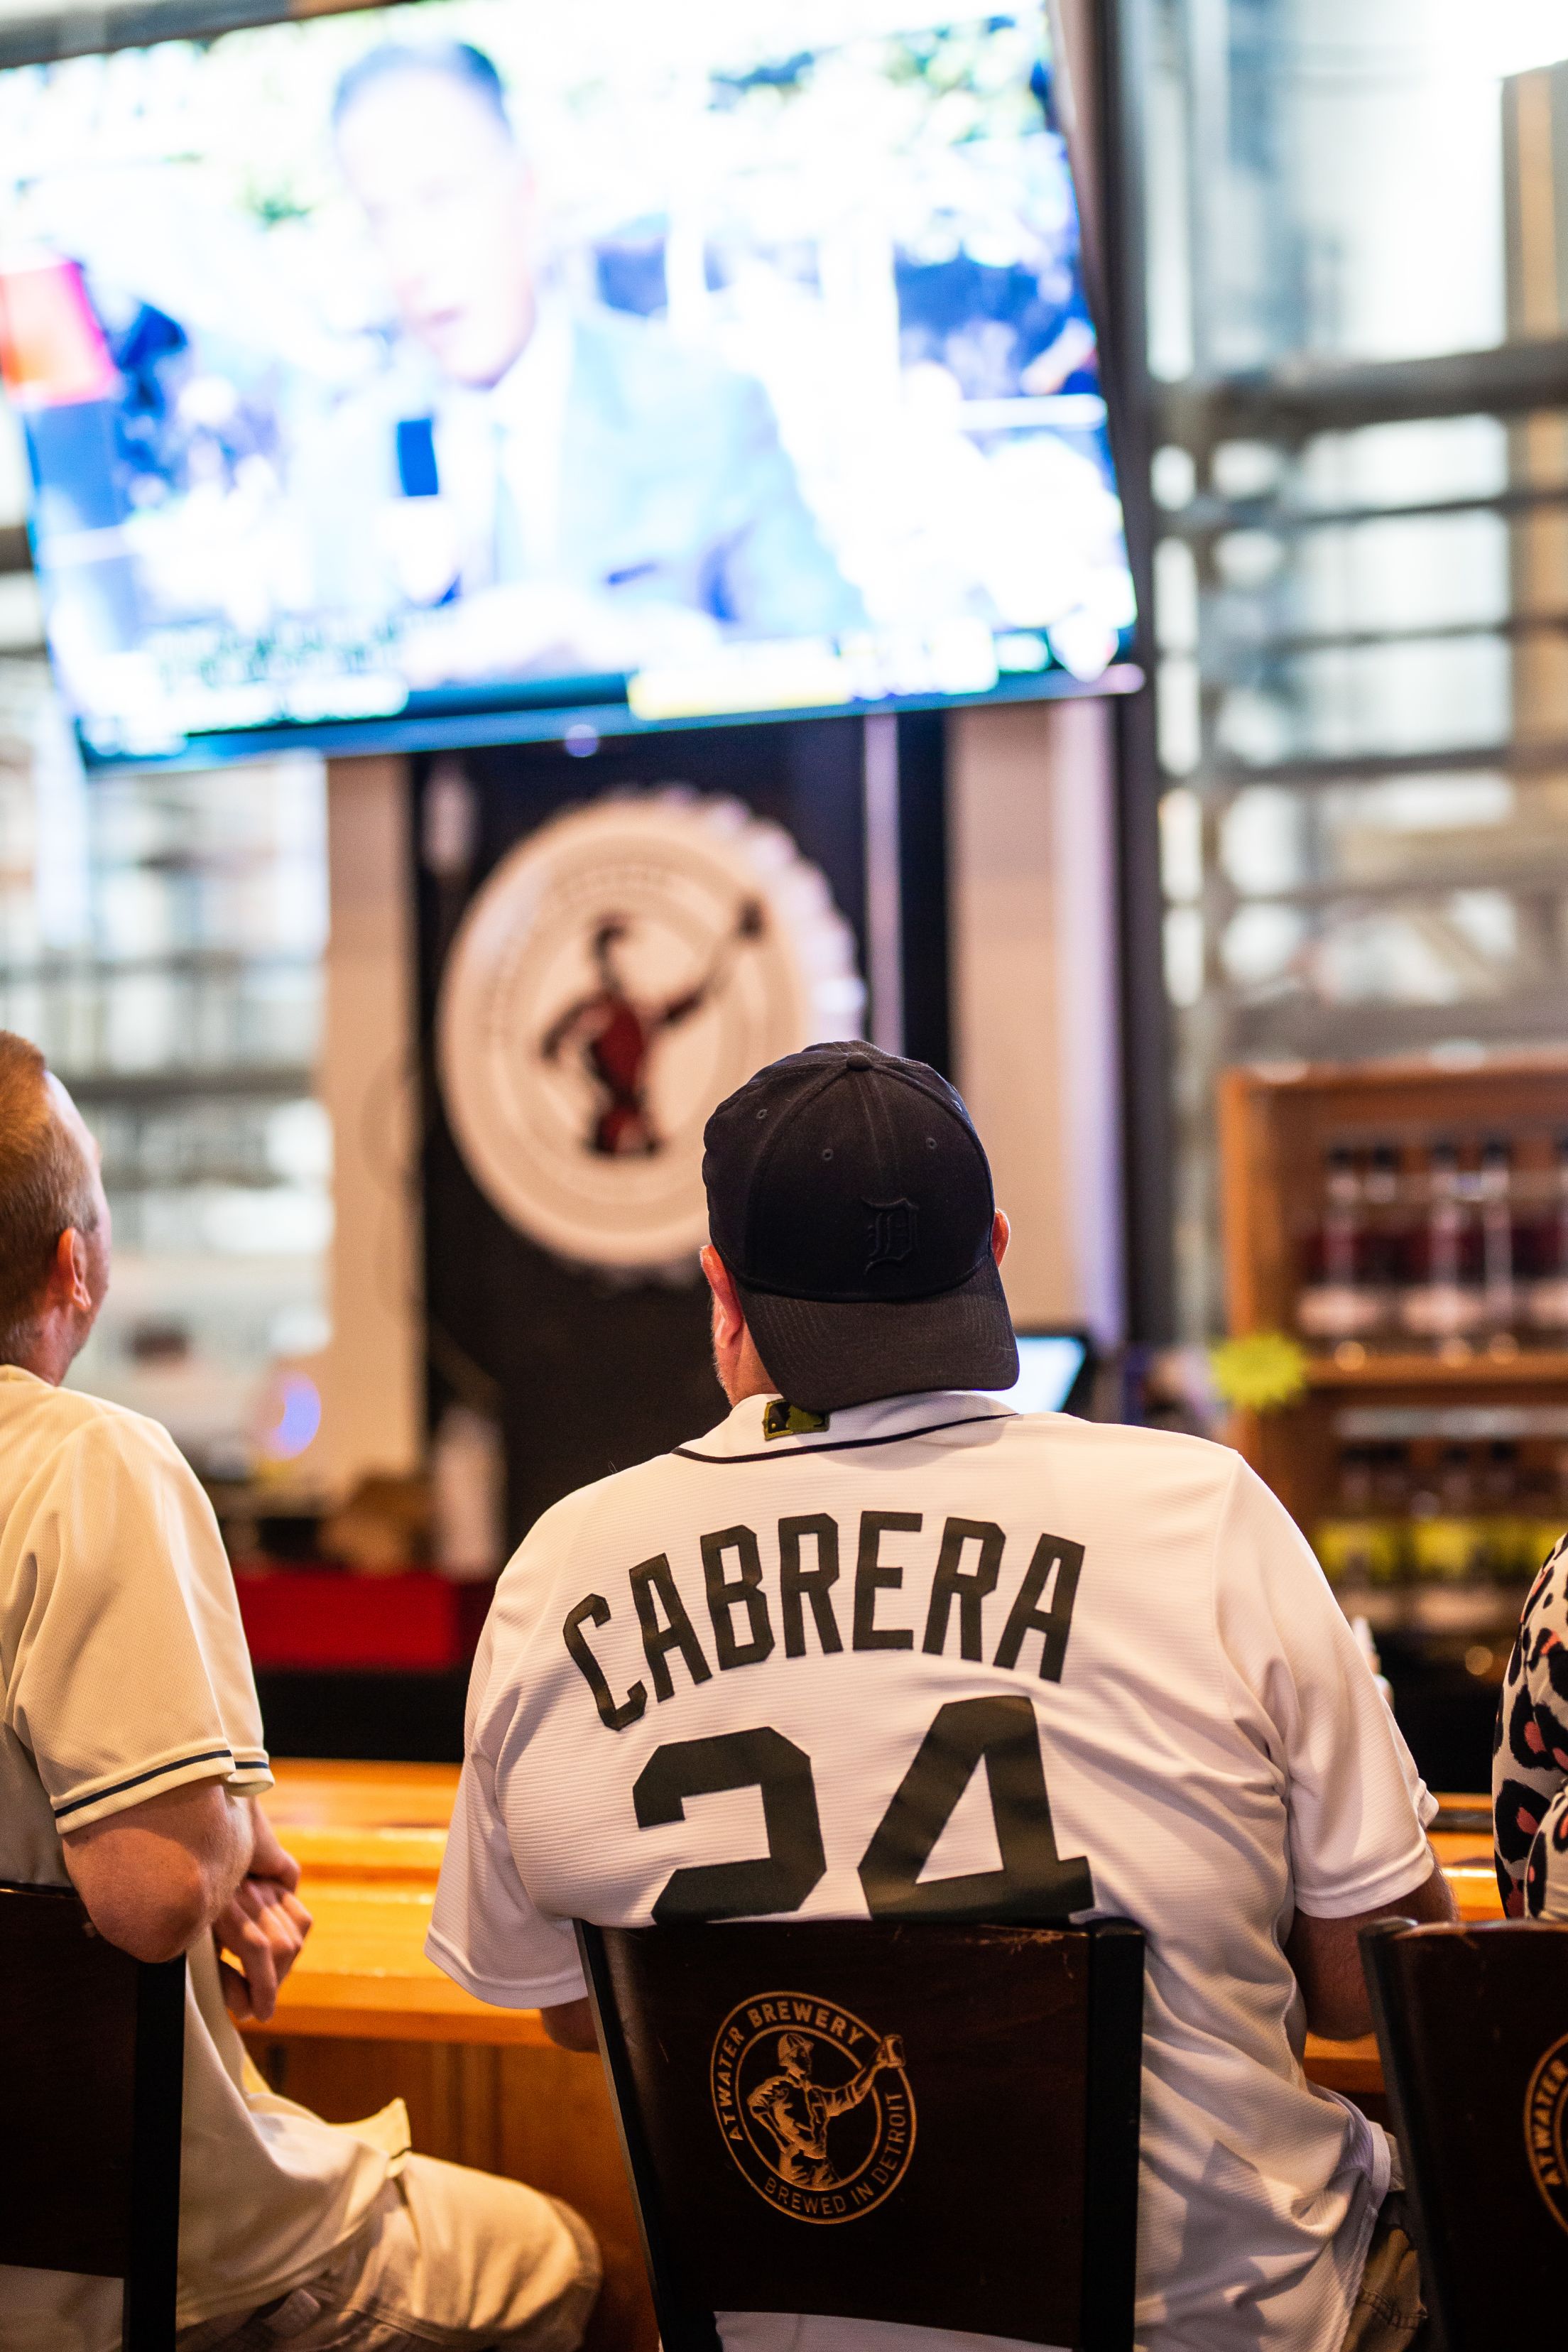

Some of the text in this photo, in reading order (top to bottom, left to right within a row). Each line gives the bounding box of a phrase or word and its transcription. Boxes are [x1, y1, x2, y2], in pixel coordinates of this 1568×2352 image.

[861, 1197, 920, 1275] D
[563, 1510, 1086, 1731] CABRERA
[632, 1695, 1095, 1925] 24
[717, 2000, 865, 2140] ATWATER BREWERY
[765, 2094, 906, 2214] BREWED IN DETROIT
